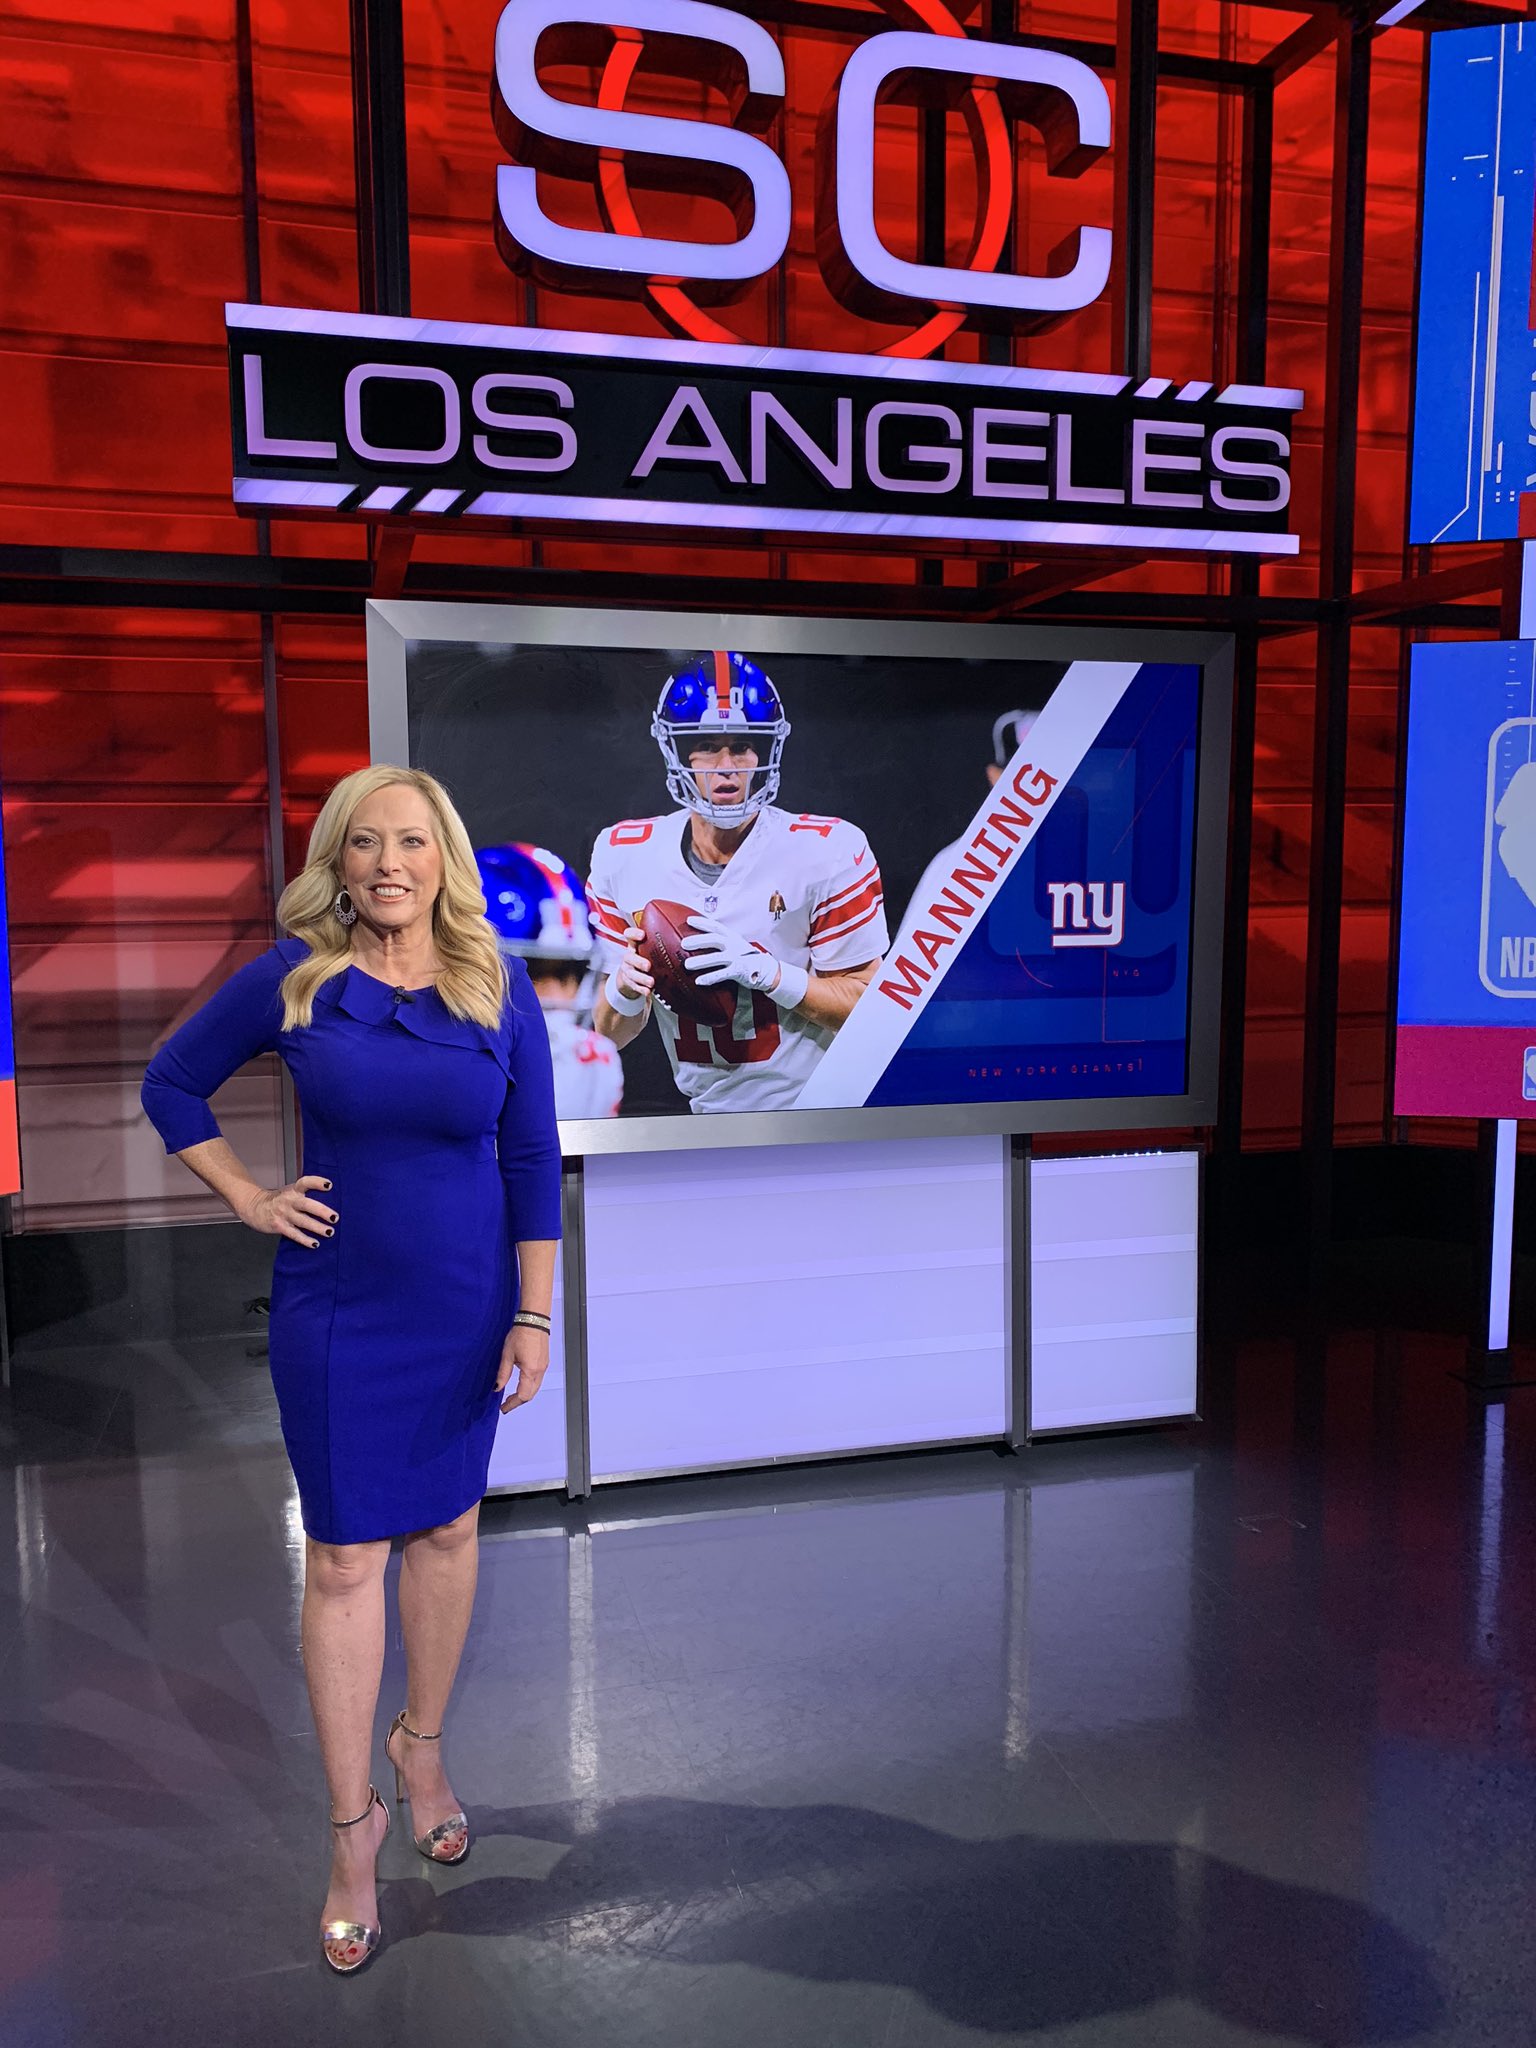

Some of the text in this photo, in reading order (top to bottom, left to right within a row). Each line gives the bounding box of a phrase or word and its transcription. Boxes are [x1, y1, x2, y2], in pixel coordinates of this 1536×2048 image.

[496, 0, 1112, 311] SC
[242, 354, 1292, 513] LOS ANGELES
[878, 763, 1059, 1011] MANNING
[968, 1062, 1134, 1078] NEW YORK GIANTS
